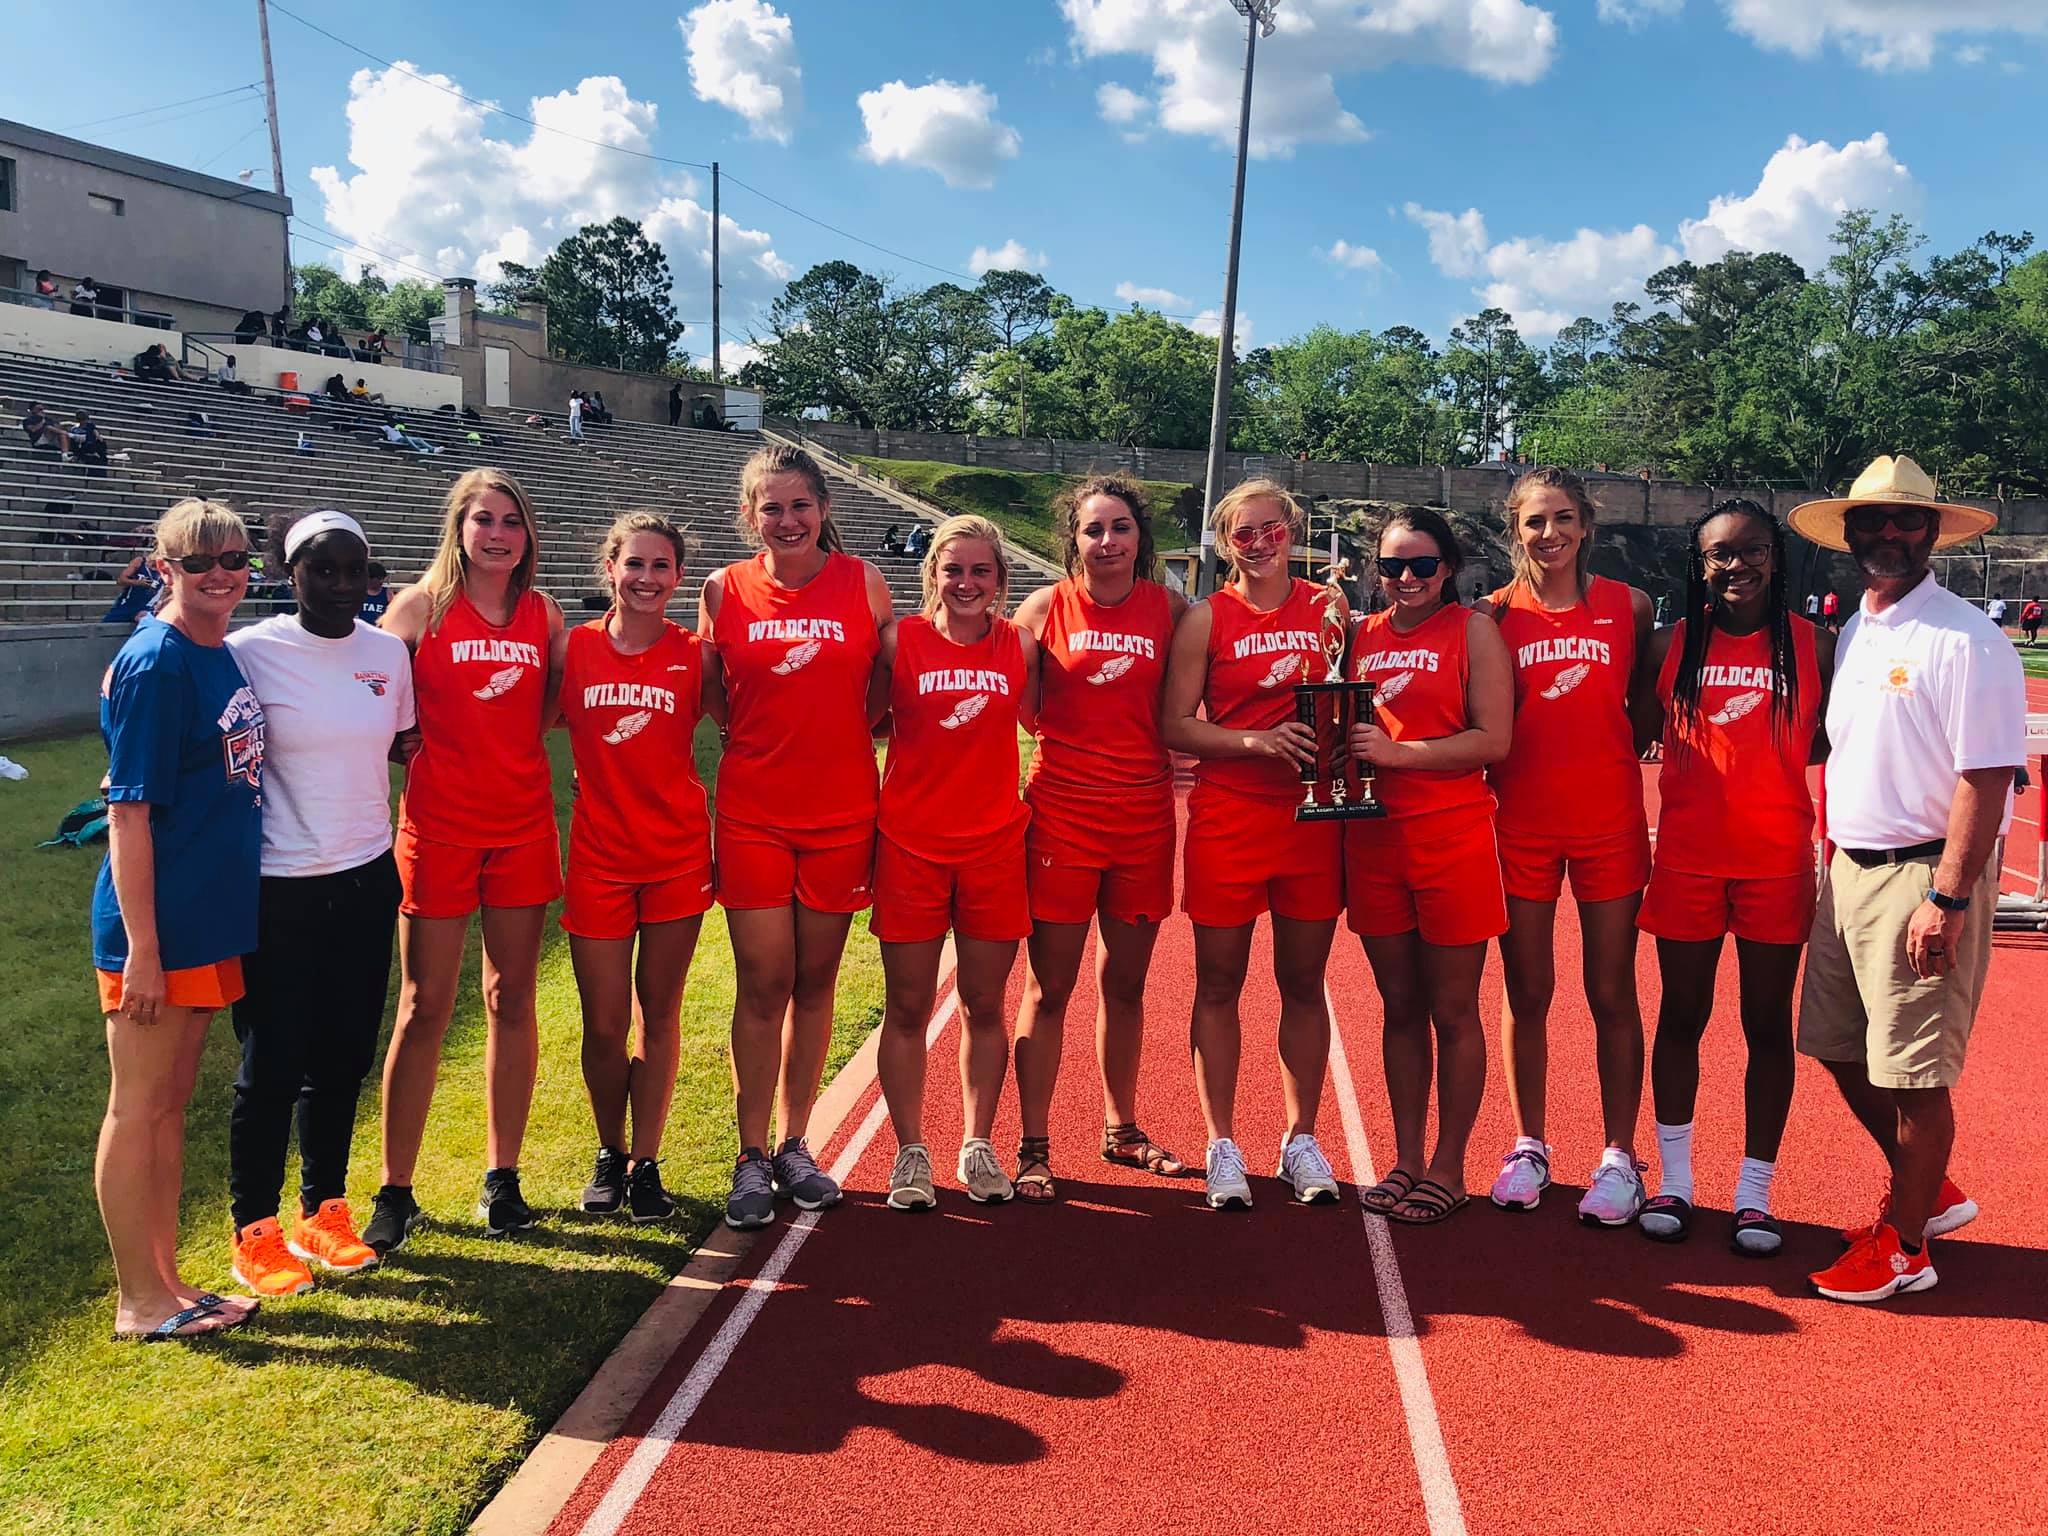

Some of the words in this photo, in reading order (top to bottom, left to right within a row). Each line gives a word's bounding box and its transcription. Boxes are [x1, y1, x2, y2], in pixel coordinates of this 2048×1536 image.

[747, 618, 846, 643] WILDCATS
[1067, 630, 1156, 660] WILDCATS
[1233, 630, 1321, 659] WILDCATS
[450, 639, 542, 668] WILDCATS
[1517, 636, 1610, 668] WILDCATS
[917, 668, 1010, 696] WILDCATS
[583, 682, 676, 714] WILDCATS
